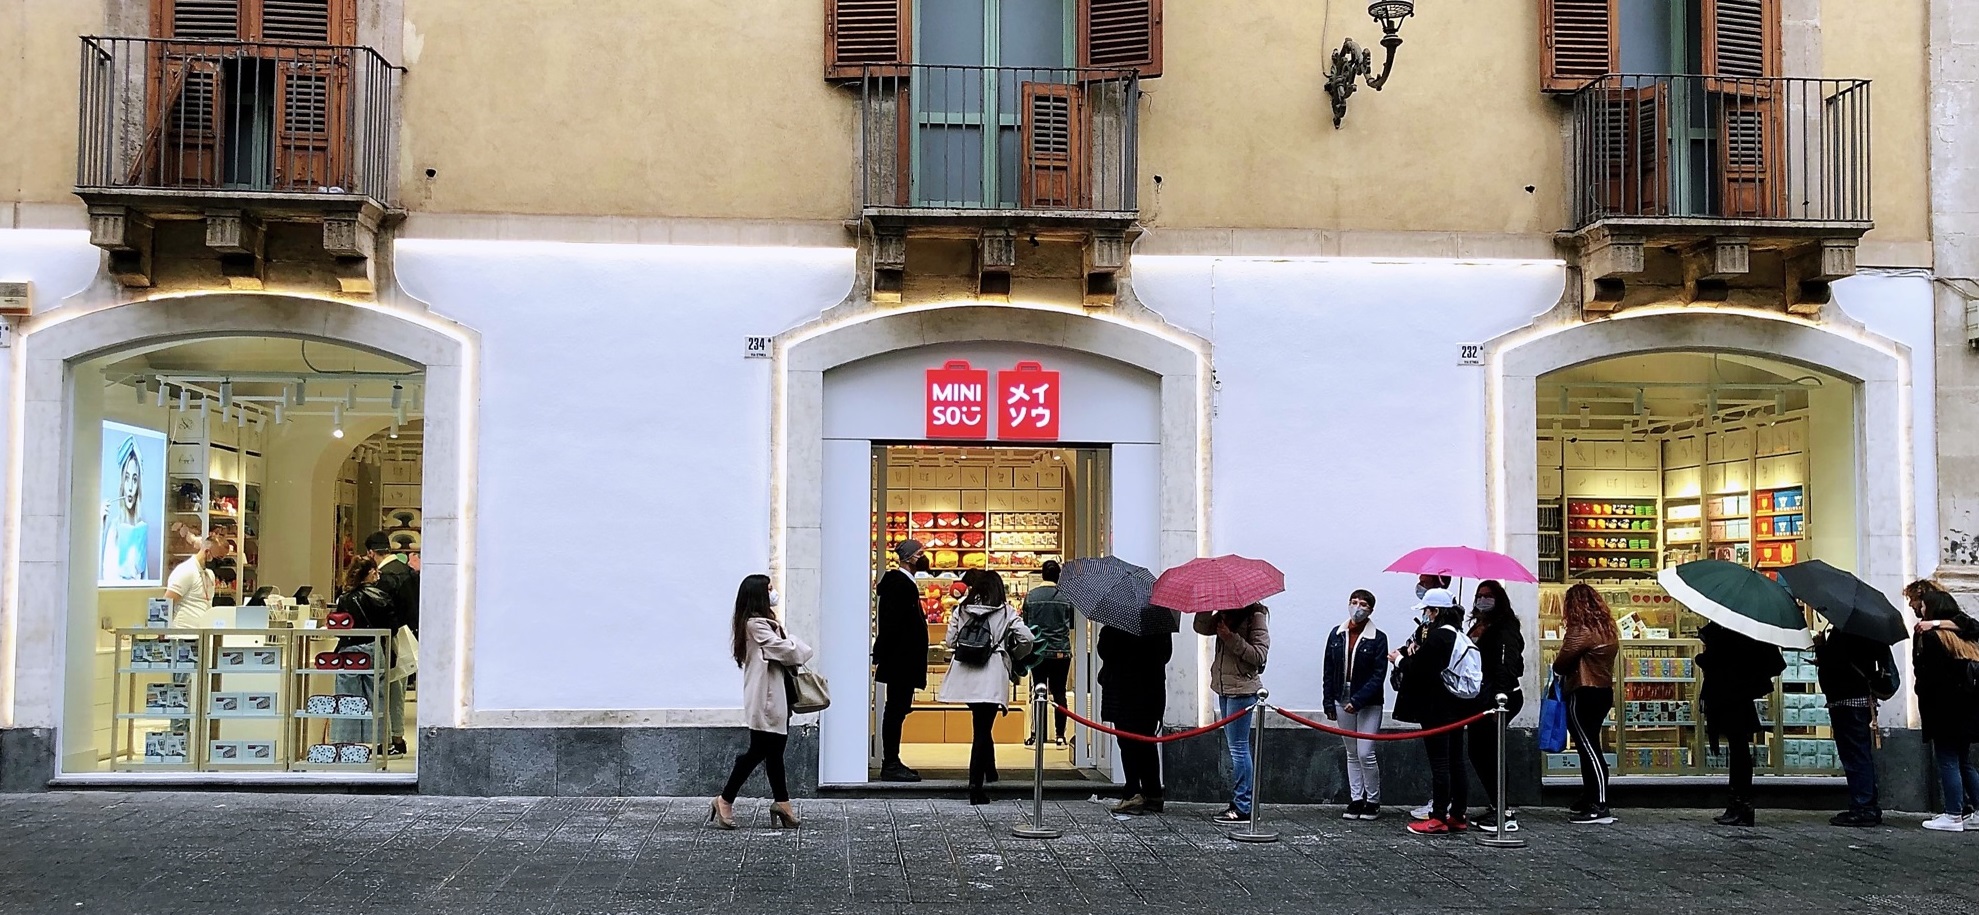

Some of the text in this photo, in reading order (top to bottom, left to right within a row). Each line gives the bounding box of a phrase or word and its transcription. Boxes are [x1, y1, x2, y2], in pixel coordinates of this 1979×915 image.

[748, 337, 765, 351] 234
[1461, 345, 1478, 359] 232
[932, 383, 982, 402] MINI
[1006, 383, 1050, 405] メイ
[1008, 406, 1051, 428] ソウ
